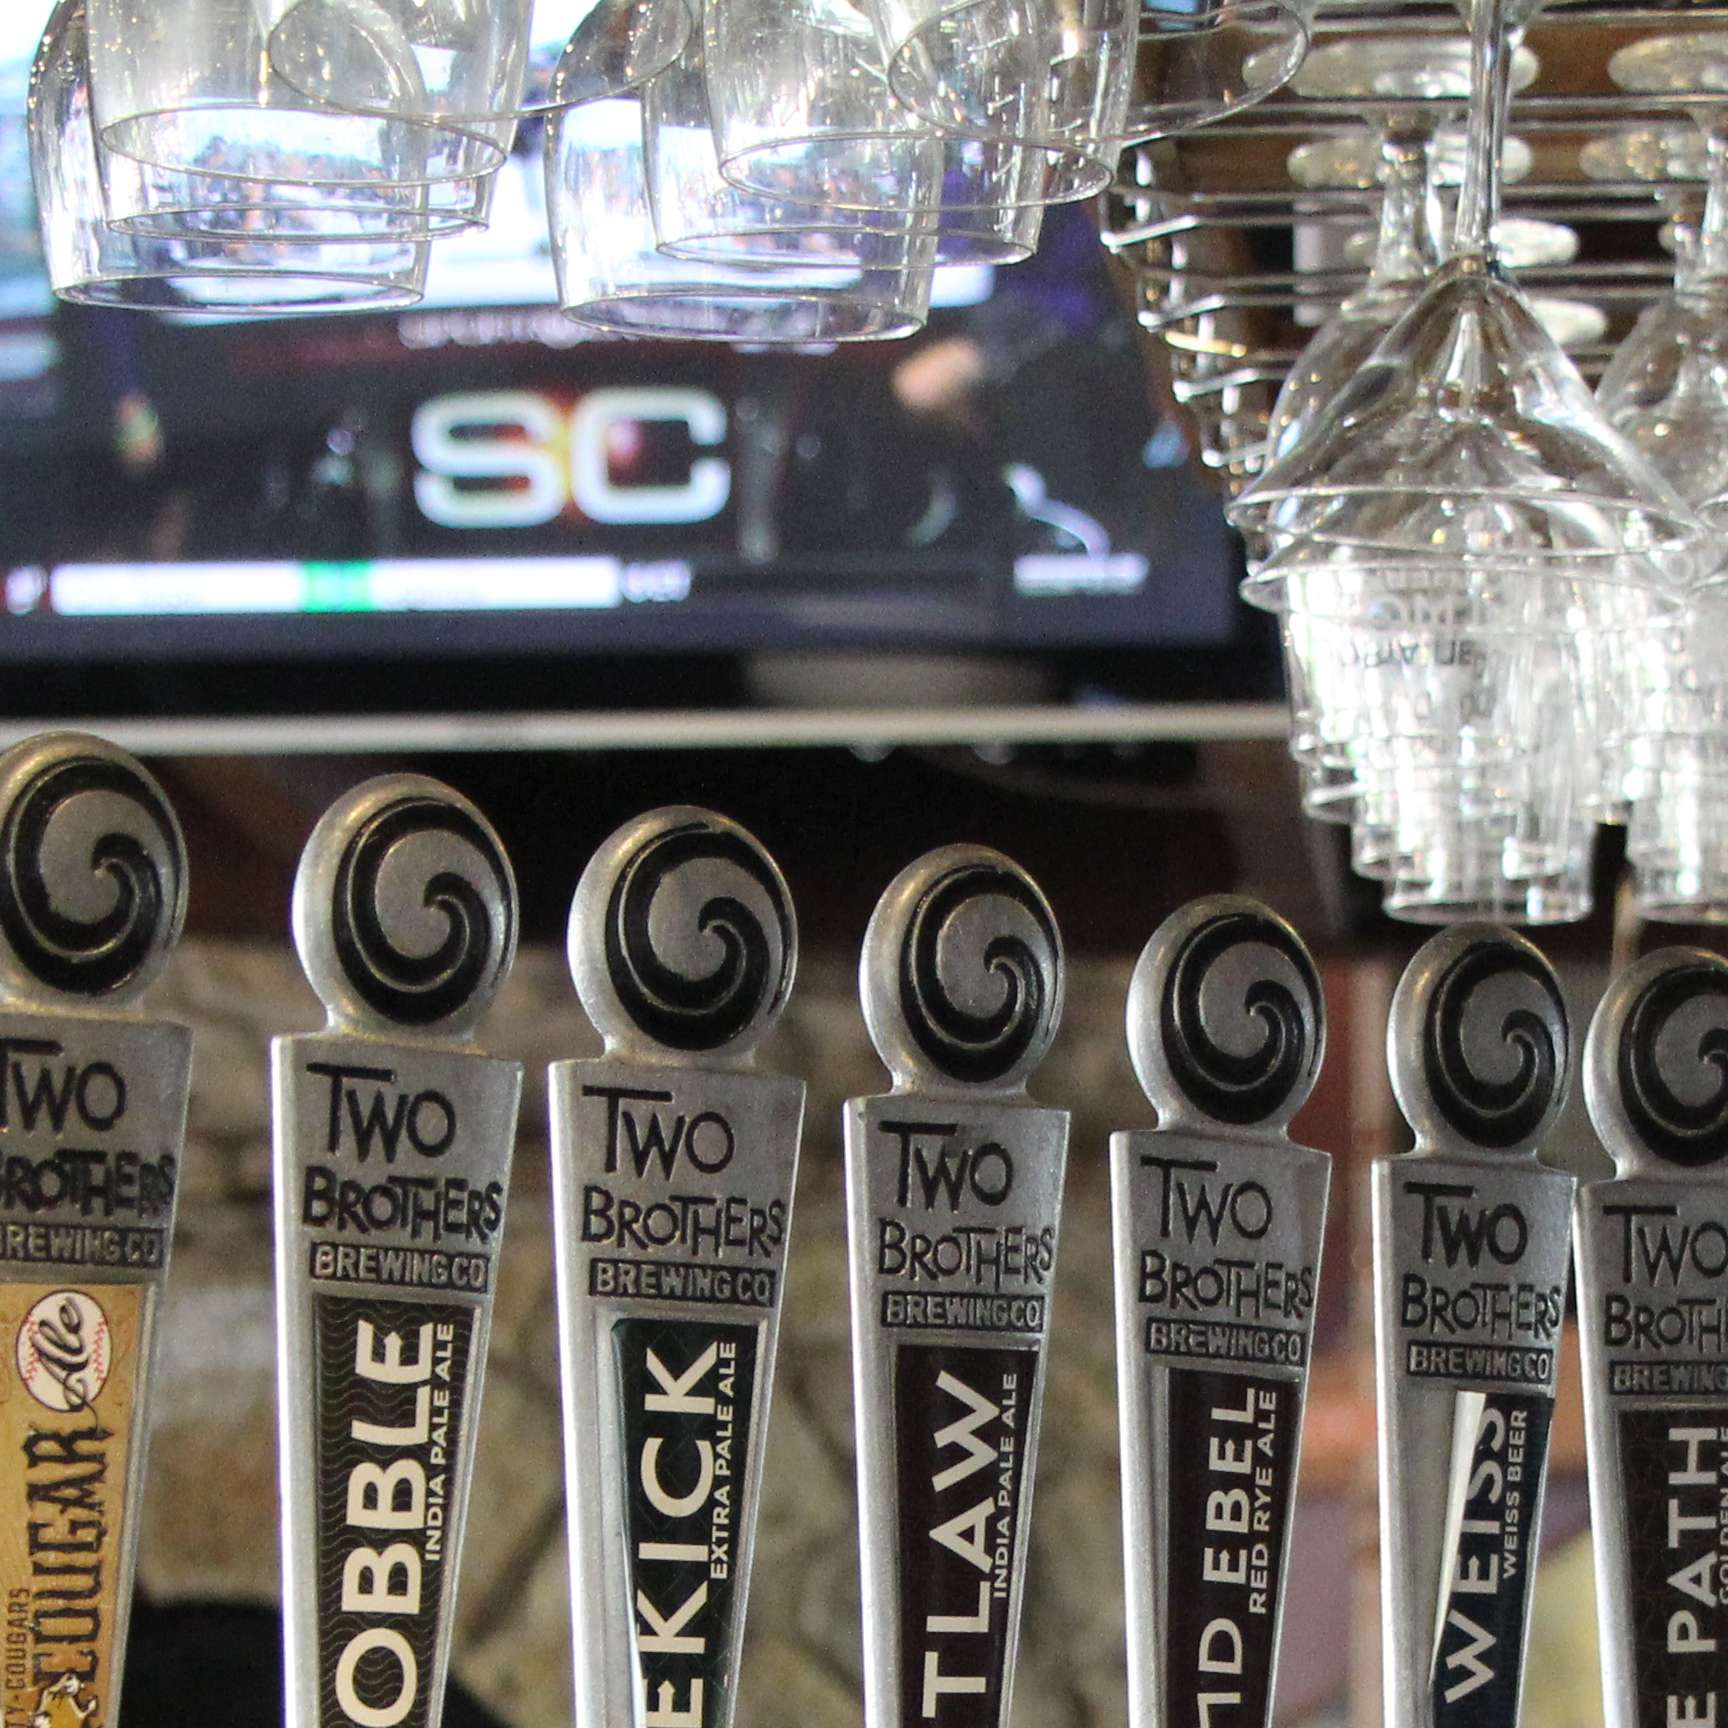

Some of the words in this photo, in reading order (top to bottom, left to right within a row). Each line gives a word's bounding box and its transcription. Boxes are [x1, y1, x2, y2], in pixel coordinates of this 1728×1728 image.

[412, 386, 732, 528] SC
[307, 1062, 456, 1163] TWO
[582, 1084, 735, 1180] TWO
[301, 1165, 503, 1243] BROTHERS
[878, 1121, 1013, 1211] TWO
[1140, 1155, 1273, 1245] TWO
[581, 1185, 783, 1258] BROTHERS
[877, 1219, 1054, 1290] BROTHERS
[1405, 1181, 1528, 1267] TWO
[314, 1246, 448, 1285] BREWING
[596, 1261, 732, 1299] BREWING
[1139, 1249, 1313, 1321] BROTHERS
[887, 1296, 1007, 1327] BREWING
[1151, 1322, 1270, 1357] BREWING
[1401, 1274, 1562, 1341] BROTHERS
[36, 1296, 94, 1412] Ale
[438, 1323, 455, 1381] ALE
[720, 1342, 736, 1398] ALE
[1410, 1344, 1520, 1377] BREWING
[432, 1385, 450, 1465] PALE
[715, 1403, 733, 1476] PALE
[1000, 1373, 1017, 1429] ALE
[1256, 1390, 1276, 1458] ALE
[994, 1436, 1014, 1506] PALE
[1203, 1388, 1256, 1584] EBEL
[1508, 1409, 1527, 1486] BEER
[425, 1472, 446, 1561] INDIA
[710, 1483, 731, 1579] EXTRA
[1251, 1468, 1272, 1535] RYE
[1502, 1493, 1520, 1579] WEISS
[1667, 1427, 1719, 1653] PATH
[26, 1425, 114, 1686] COUGAR
[992, 1515, 1013, 1598] INDIA
[1249, 1543, 1269, 1614] RED
[1445, 1406, 1506, 1703] WEISS
[5, 1587, 30, 1690] COUGARS
